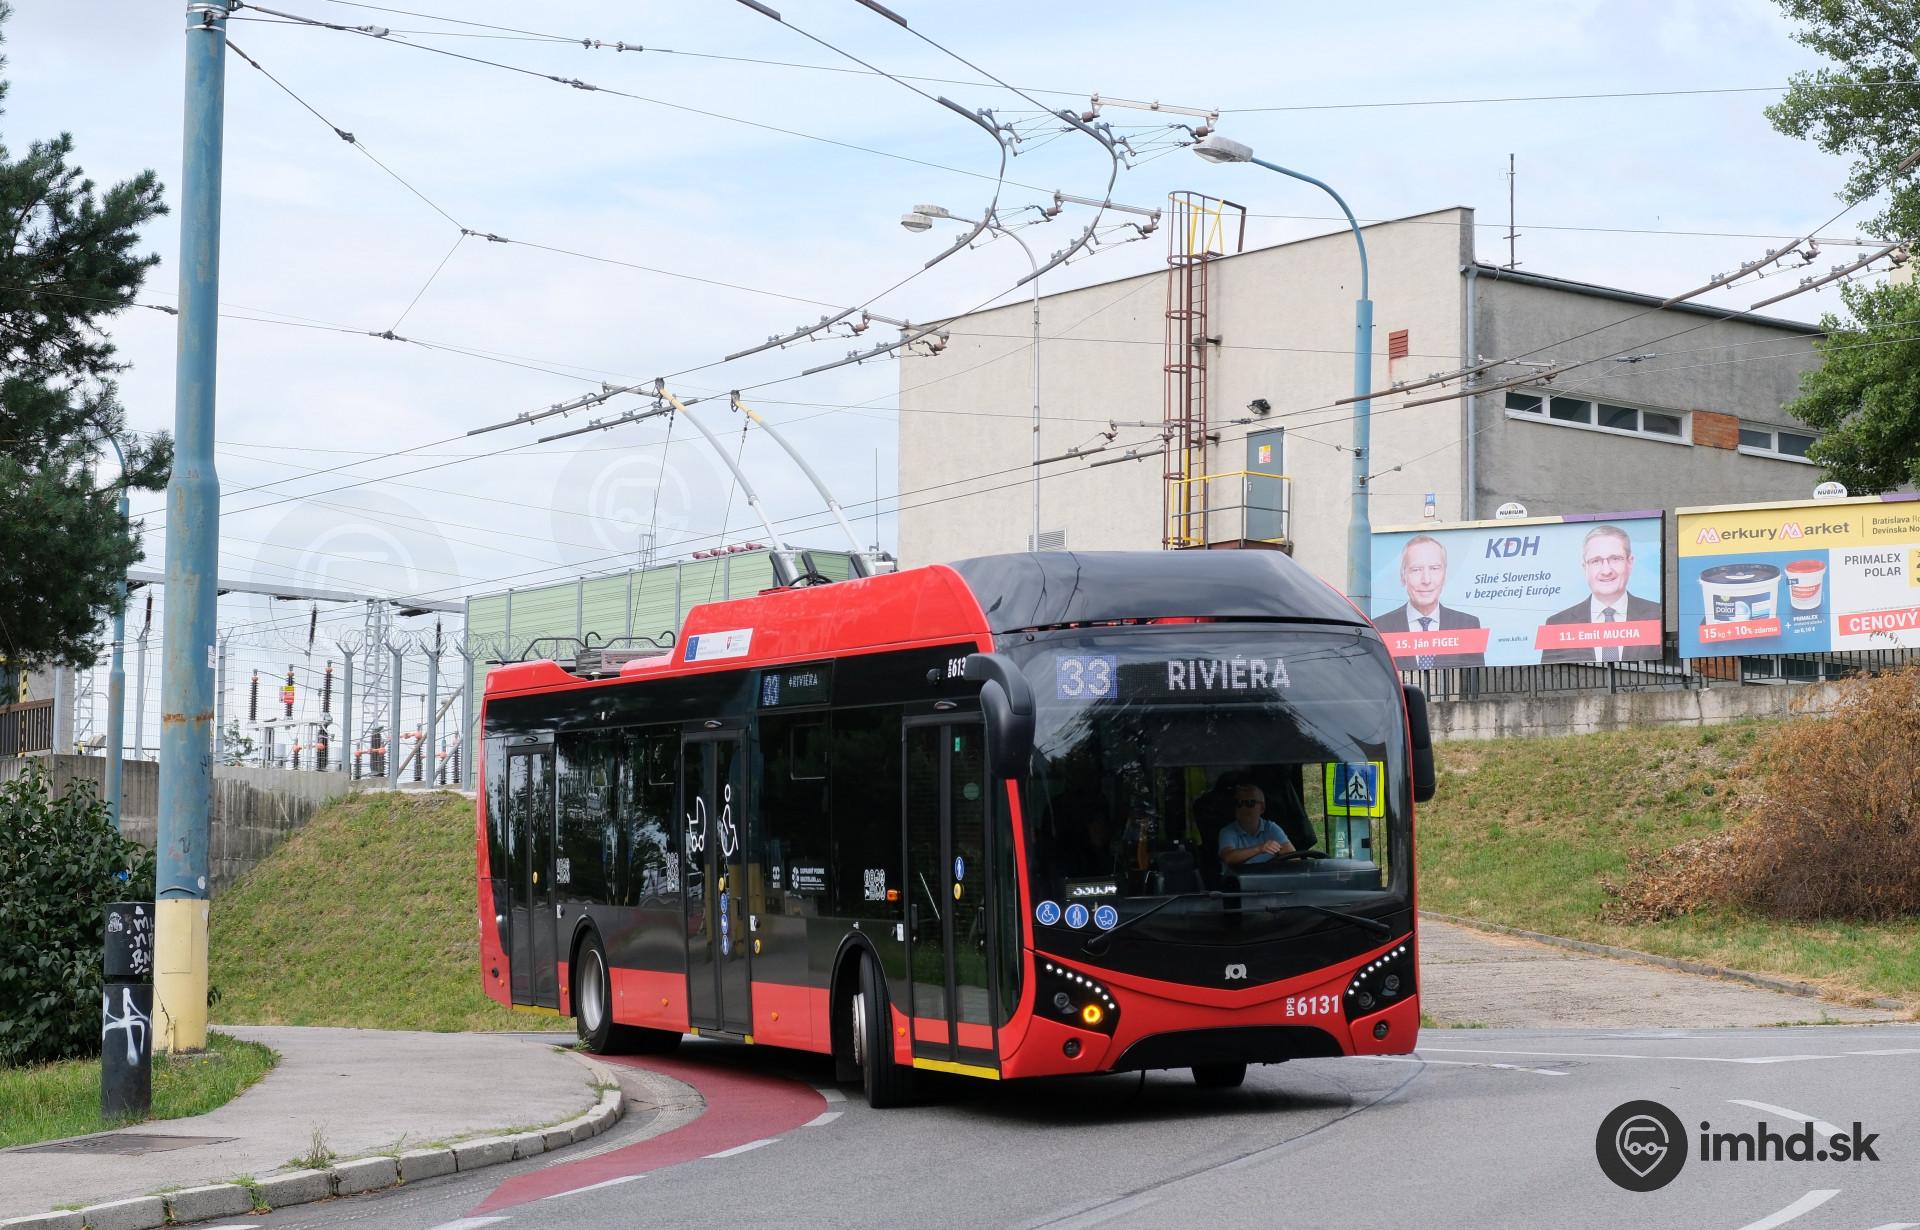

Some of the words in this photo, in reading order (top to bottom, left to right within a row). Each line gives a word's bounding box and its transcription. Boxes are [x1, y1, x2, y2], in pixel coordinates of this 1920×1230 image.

[1872, 516, 1910, 526] Bratislava
[1696, 526, 1778, 544] Merkury
[1779, 521, 1850, 540] Market
[1872, 525, 1908, 535] Devinska
[1485, 535, 1541, 559] KDH
[1844, 553, 1902, 566] PRIMALEX
[1474, 573, 1499, 585] Silné
[1502, 570, 1552, 583] Slovensko
[1864, 567, 1902, 578] POLAR
[1475, 585, 1523, 600] bezpečnej
[1526, 584, 1561, 599] Európe
[1850, 608, 1918, 632] CENOVÝ
[1559, 631, 1575, 641] 11.
[1578, 629, 1600, 640] Emil
[1603, 628, 1640, 640] MUCHA
[1703, 628, 1717, 639] 15
[1396, 640, 1411, 649] 15.
[1414, 638, 1429, 650] Ján
[952, 656, 967, 678] 613
[1168, 654, 1291, 691] RIVIÉRA
[1061, 658, 1111, 697] 33
[1286, 997, 1295, 1017] DPB
[1297, 994, 1339, 1016] 6131
